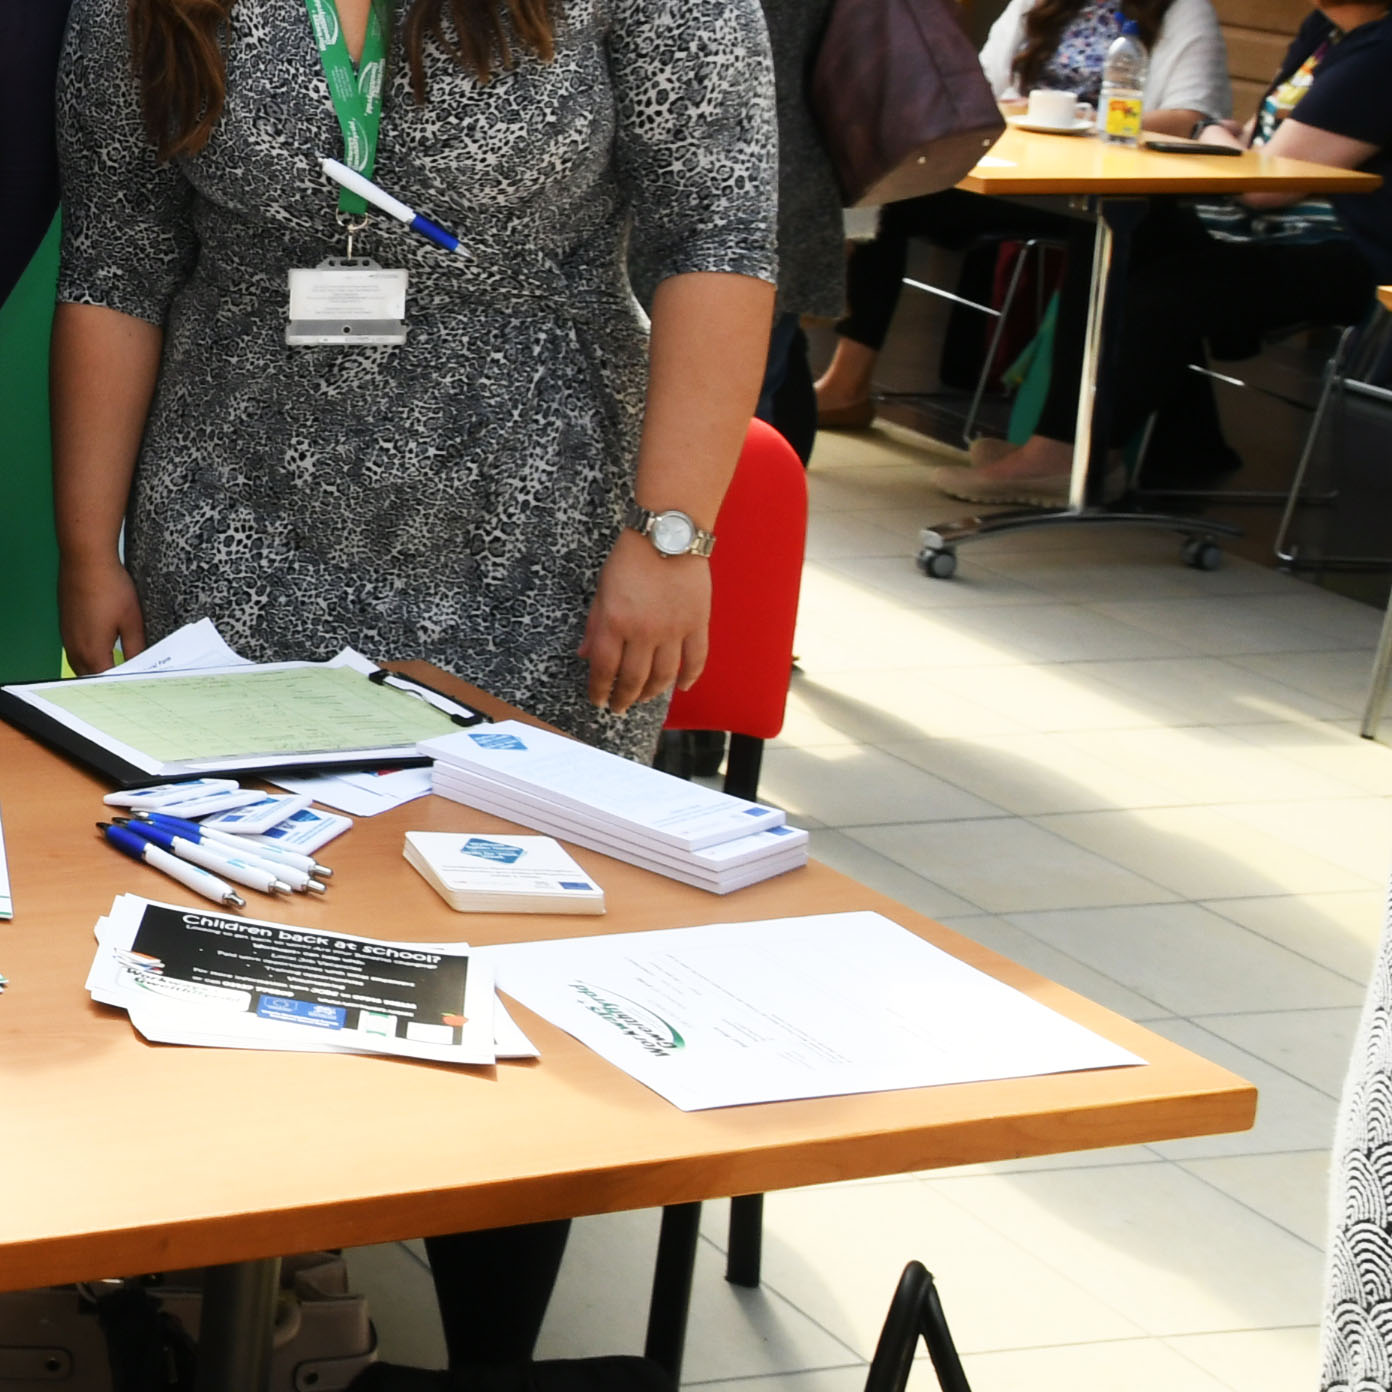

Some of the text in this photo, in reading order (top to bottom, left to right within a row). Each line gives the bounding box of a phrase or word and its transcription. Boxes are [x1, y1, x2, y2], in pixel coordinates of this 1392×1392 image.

[182, 914, 441, 964] Children back at school?
